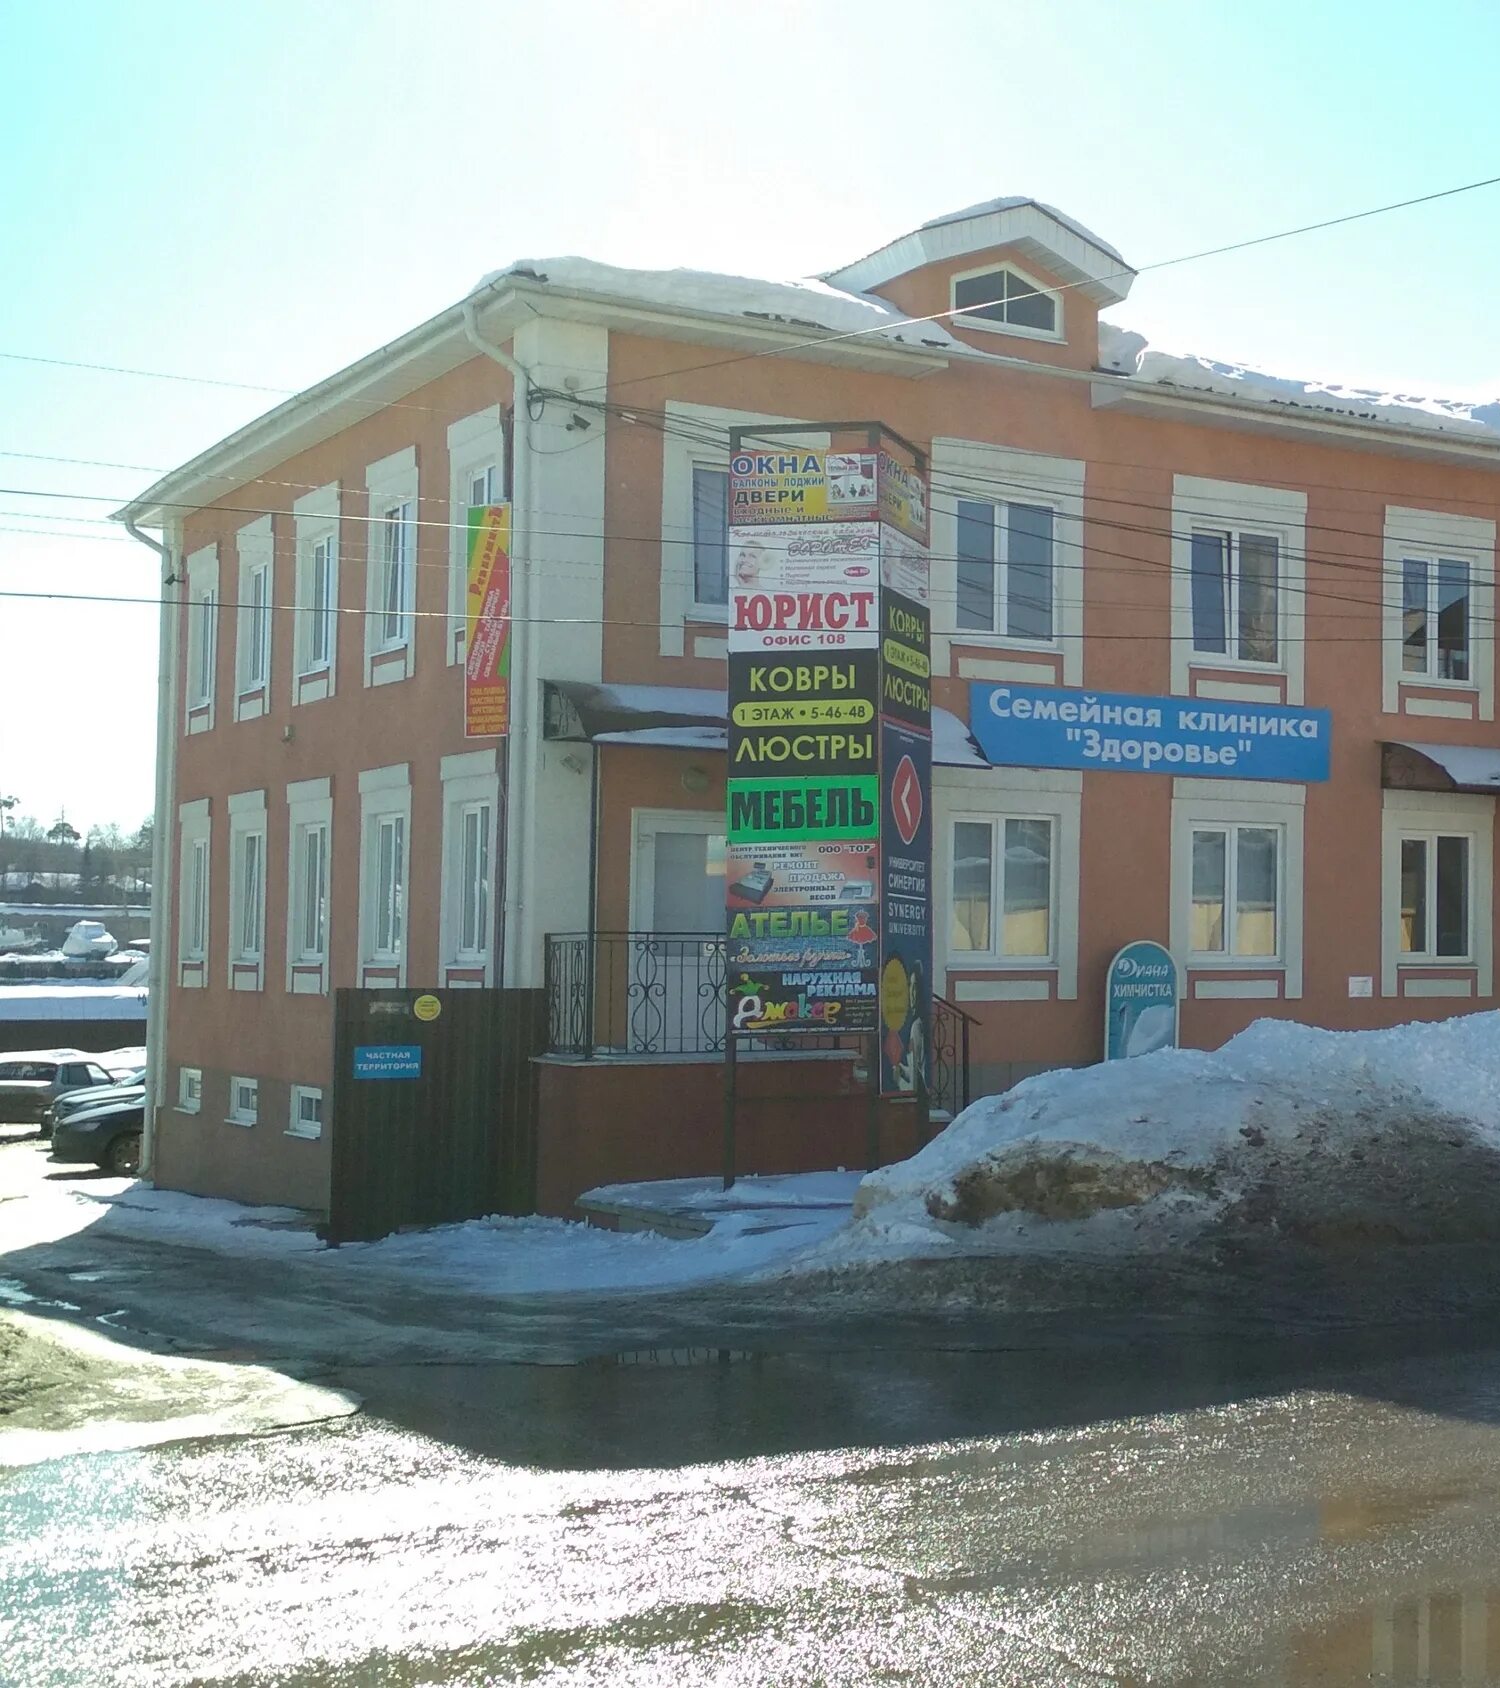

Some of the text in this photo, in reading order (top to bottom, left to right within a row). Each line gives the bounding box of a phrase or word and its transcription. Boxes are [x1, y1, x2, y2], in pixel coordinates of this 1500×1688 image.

[732, 455, 822, 476] ОКНА
[732, 476, 824, 488] БАЛКОНЫ ЛОДЖИИ
[734, 489, 804, 506] ДВЕРИ
[734, 592, 874, 631] ЮРИСТ
[889, 606, 925, 644] КОВРЫ
[762, 634, 846, 646] ОФИС 108
[750, 665, 856, 692] КОВРЫ
[884, 673, 930, 712] ЛЮСТРЫ
[740, 706, 866, 721] 1 ЭТАЖ 5-46-48
[989, 688, 1318, 739] Семейная клиника
[735, 734, 873, 762] ЛЮСТРЫ
[1066, 728, 1252, 768] "Здоровье"
[731, 788, 874, 831] МЕБЕЛЬ
[818, 846, 841, 854] ООО
[773, 860, 820, 870] РЕМОНТ
[788, 872, 846, 882] ПРОДАЖА
[888, 872, 925, 893] СИНЕРГИЯ
[888, 902, 926, 920] SYNERGY
[730, 909, 849, 939] АТЕЛЬЕ
[888, 922, 926, 937] UNIVERSITY
[782, 971, 861, 986] НАРУЖНАЯ
[807, 983, 876, 997] РЕКЛАМА
[1113, 983, 1172, 998] ХИМЧИСТКА
[356, 1063, 419, 1071] ТЕРРИТОРИЯ
